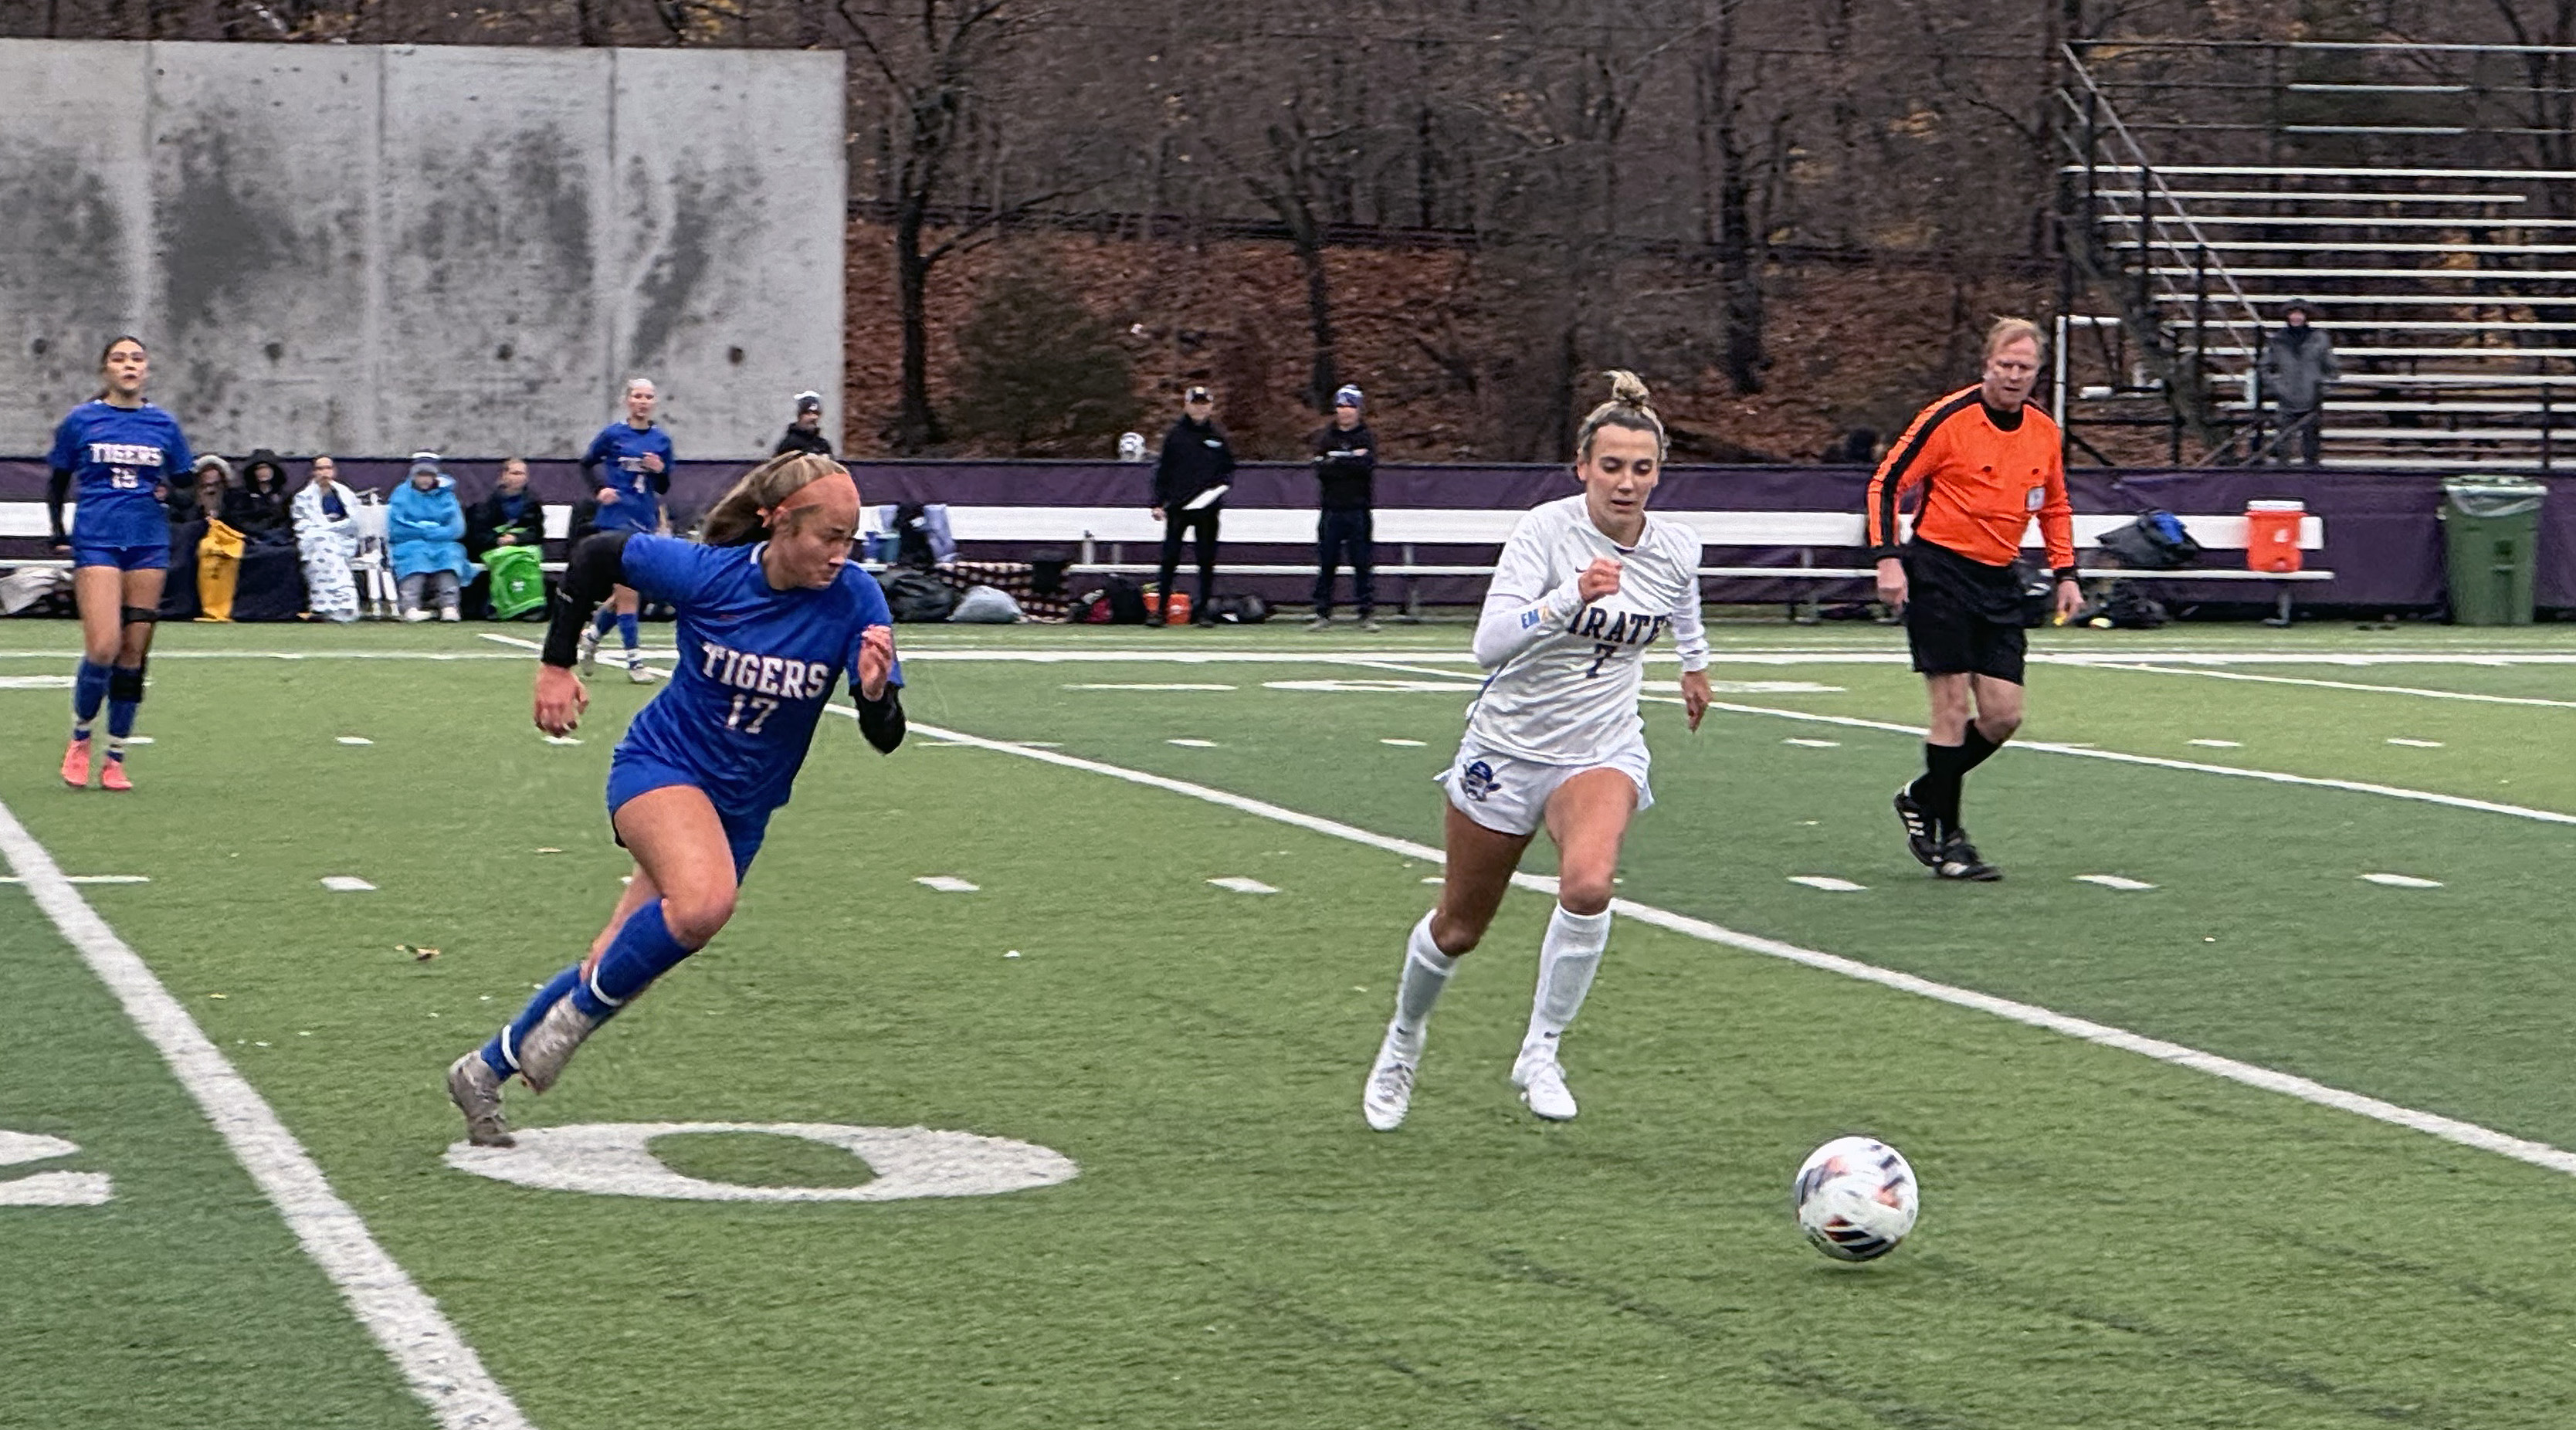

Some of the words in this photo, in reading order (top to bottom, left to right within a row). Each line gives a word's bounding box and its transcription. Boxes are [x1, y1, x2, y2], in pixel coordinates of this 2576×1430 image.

[1568, 606, 1673, 645] IRATE
[703, 642, 830, 700] TIGERS
[1586, 642, 1618, 679] 7
[724, 694, 779, 734] 17
